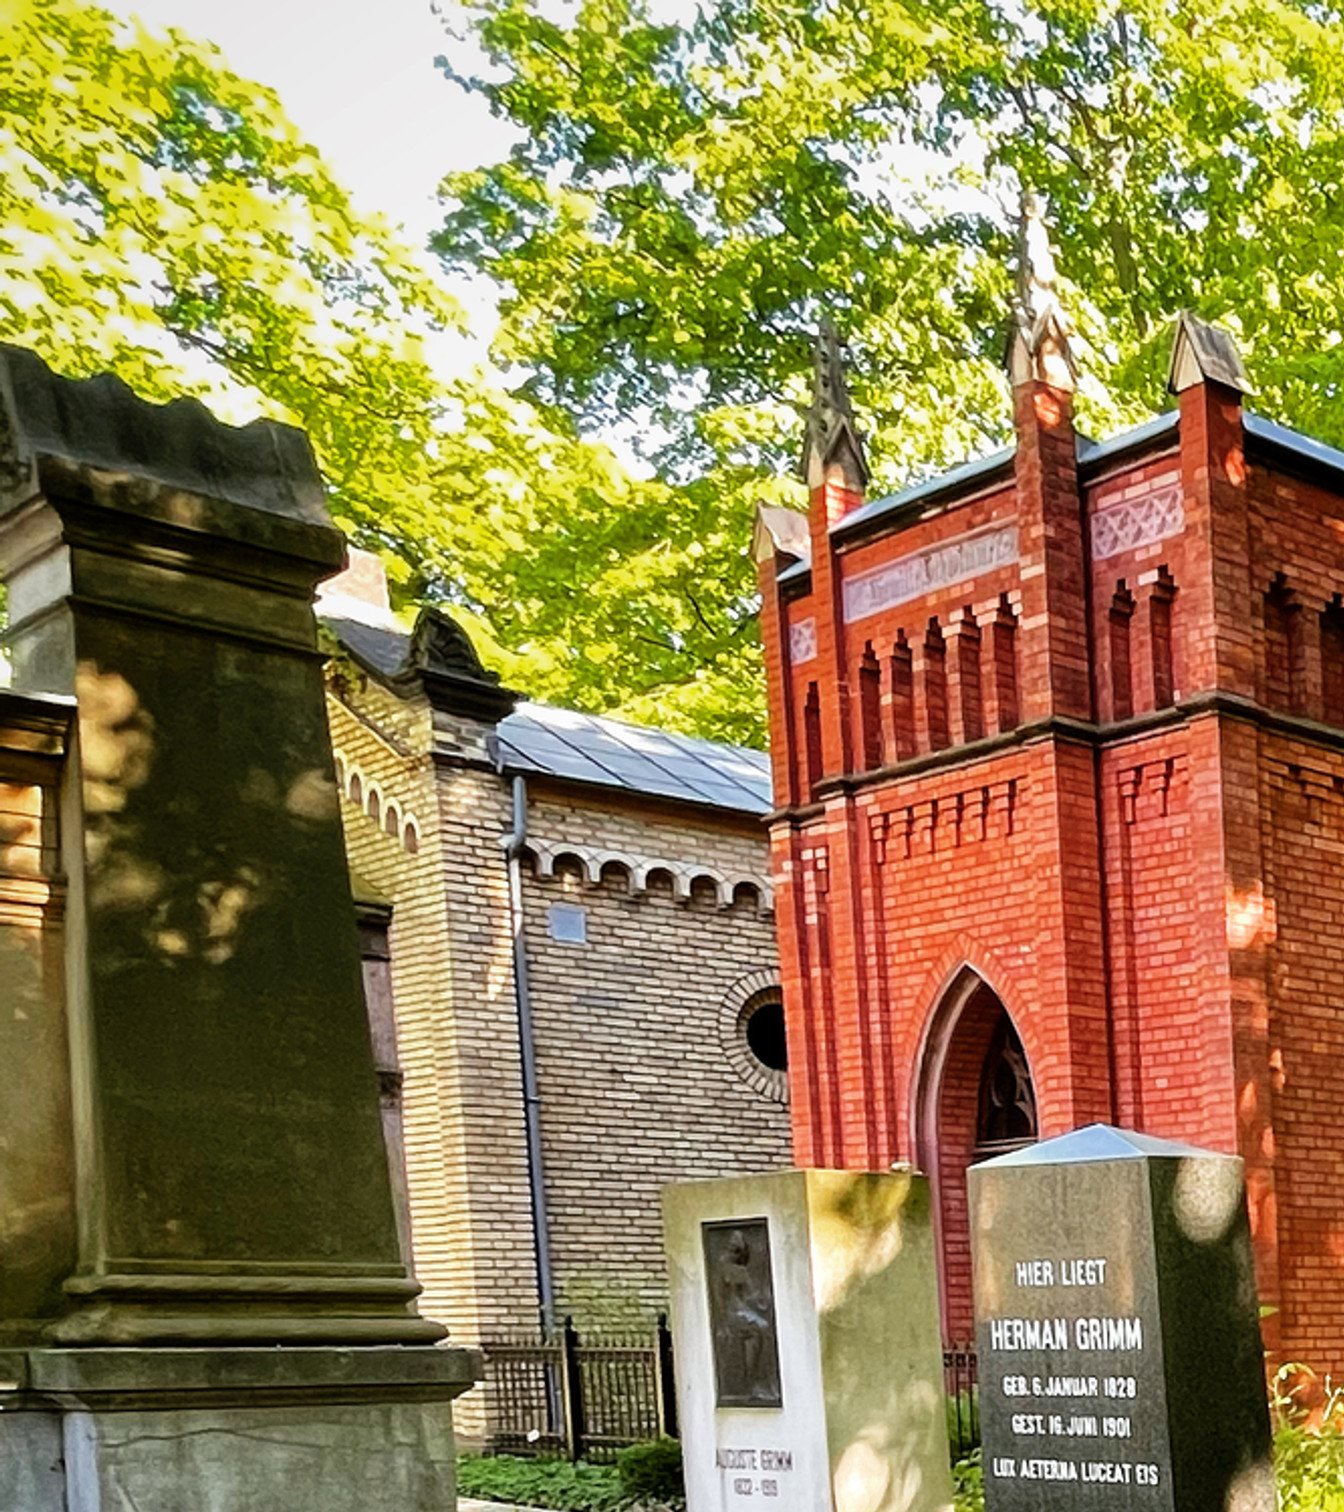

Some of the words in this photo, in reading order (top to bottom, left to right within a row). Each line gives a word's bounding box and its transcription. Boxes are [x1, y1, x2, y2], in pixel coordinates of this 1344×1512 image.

[1016, 1261, 1053, 1286] HIER
[1061, 1260, 1106, 1285] LIEGT
[991, 1318, 1068, 1350] HERMAN
[1076, 1318, 1142, 1350] GRIMM
[1003, 1377, 1030, 1396] GEB.
[1045, 1377, 1097, 1397] JANUAR
[1104, 1377, 1136, 1398] 1828
[1012, 1415, 1045, 1434] GEST.
[1103, 1418, 1131, 1437] 1901
[761, 1450, 793, 1470] GRIMM
[993, 1458, 1016, 1477] LUX
[1020, 1459, 1078, 1480] AETERNA
[1082, 1462, 1131, 1483] LUCEAT
[1136, 1464, 1158, 1485] EIS
